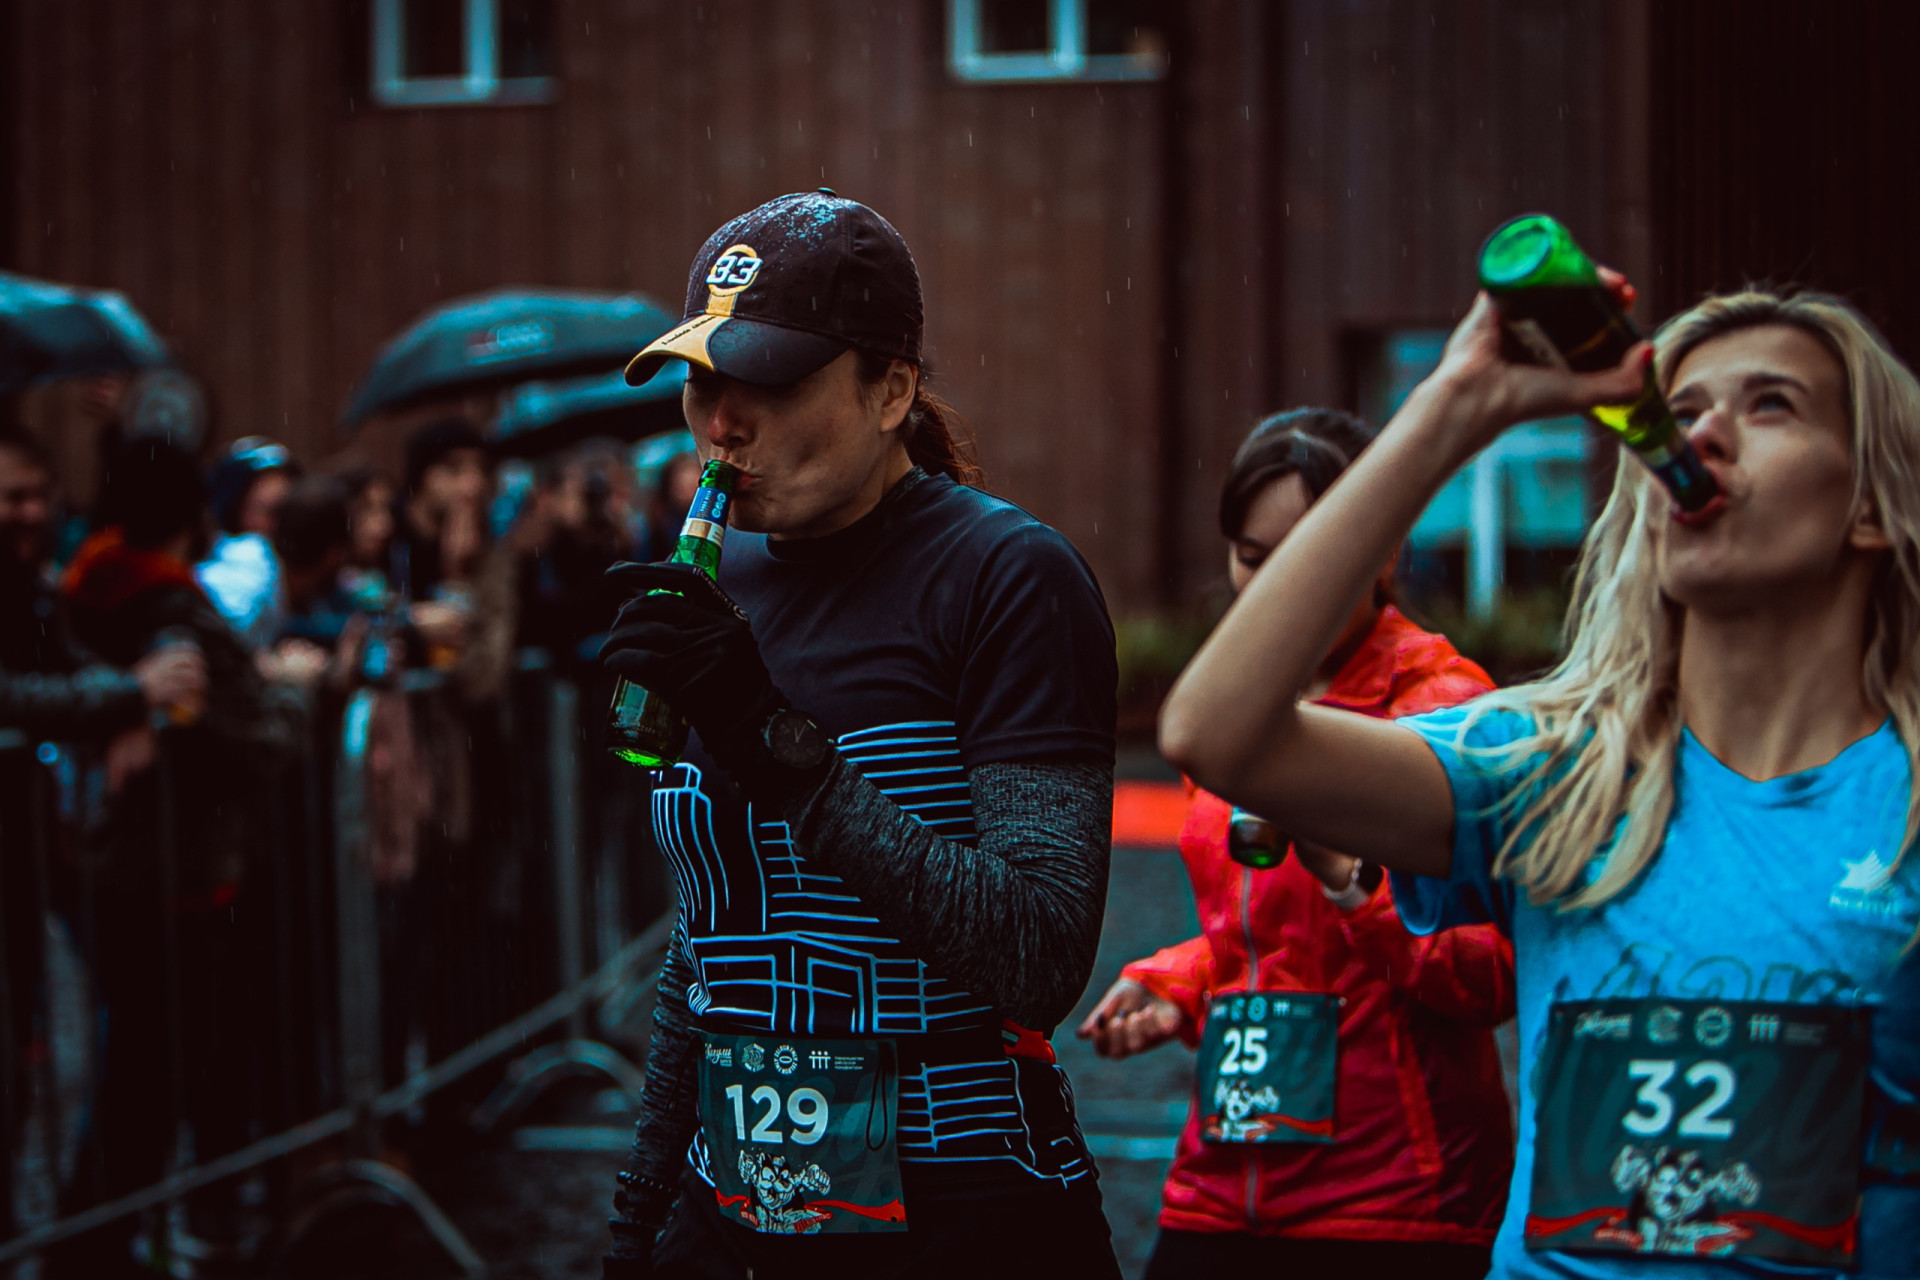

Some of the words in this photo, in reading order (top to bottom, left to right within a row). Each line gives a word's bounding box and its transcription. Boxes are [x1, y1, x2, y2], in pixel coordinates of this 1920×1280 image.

[708, 256, 763, 284] 33
[1219, 1026, 1269, 1075] 25
[726, 1084, 829, 1145] 129
[1622, 1059, 1737, 1137] 32
